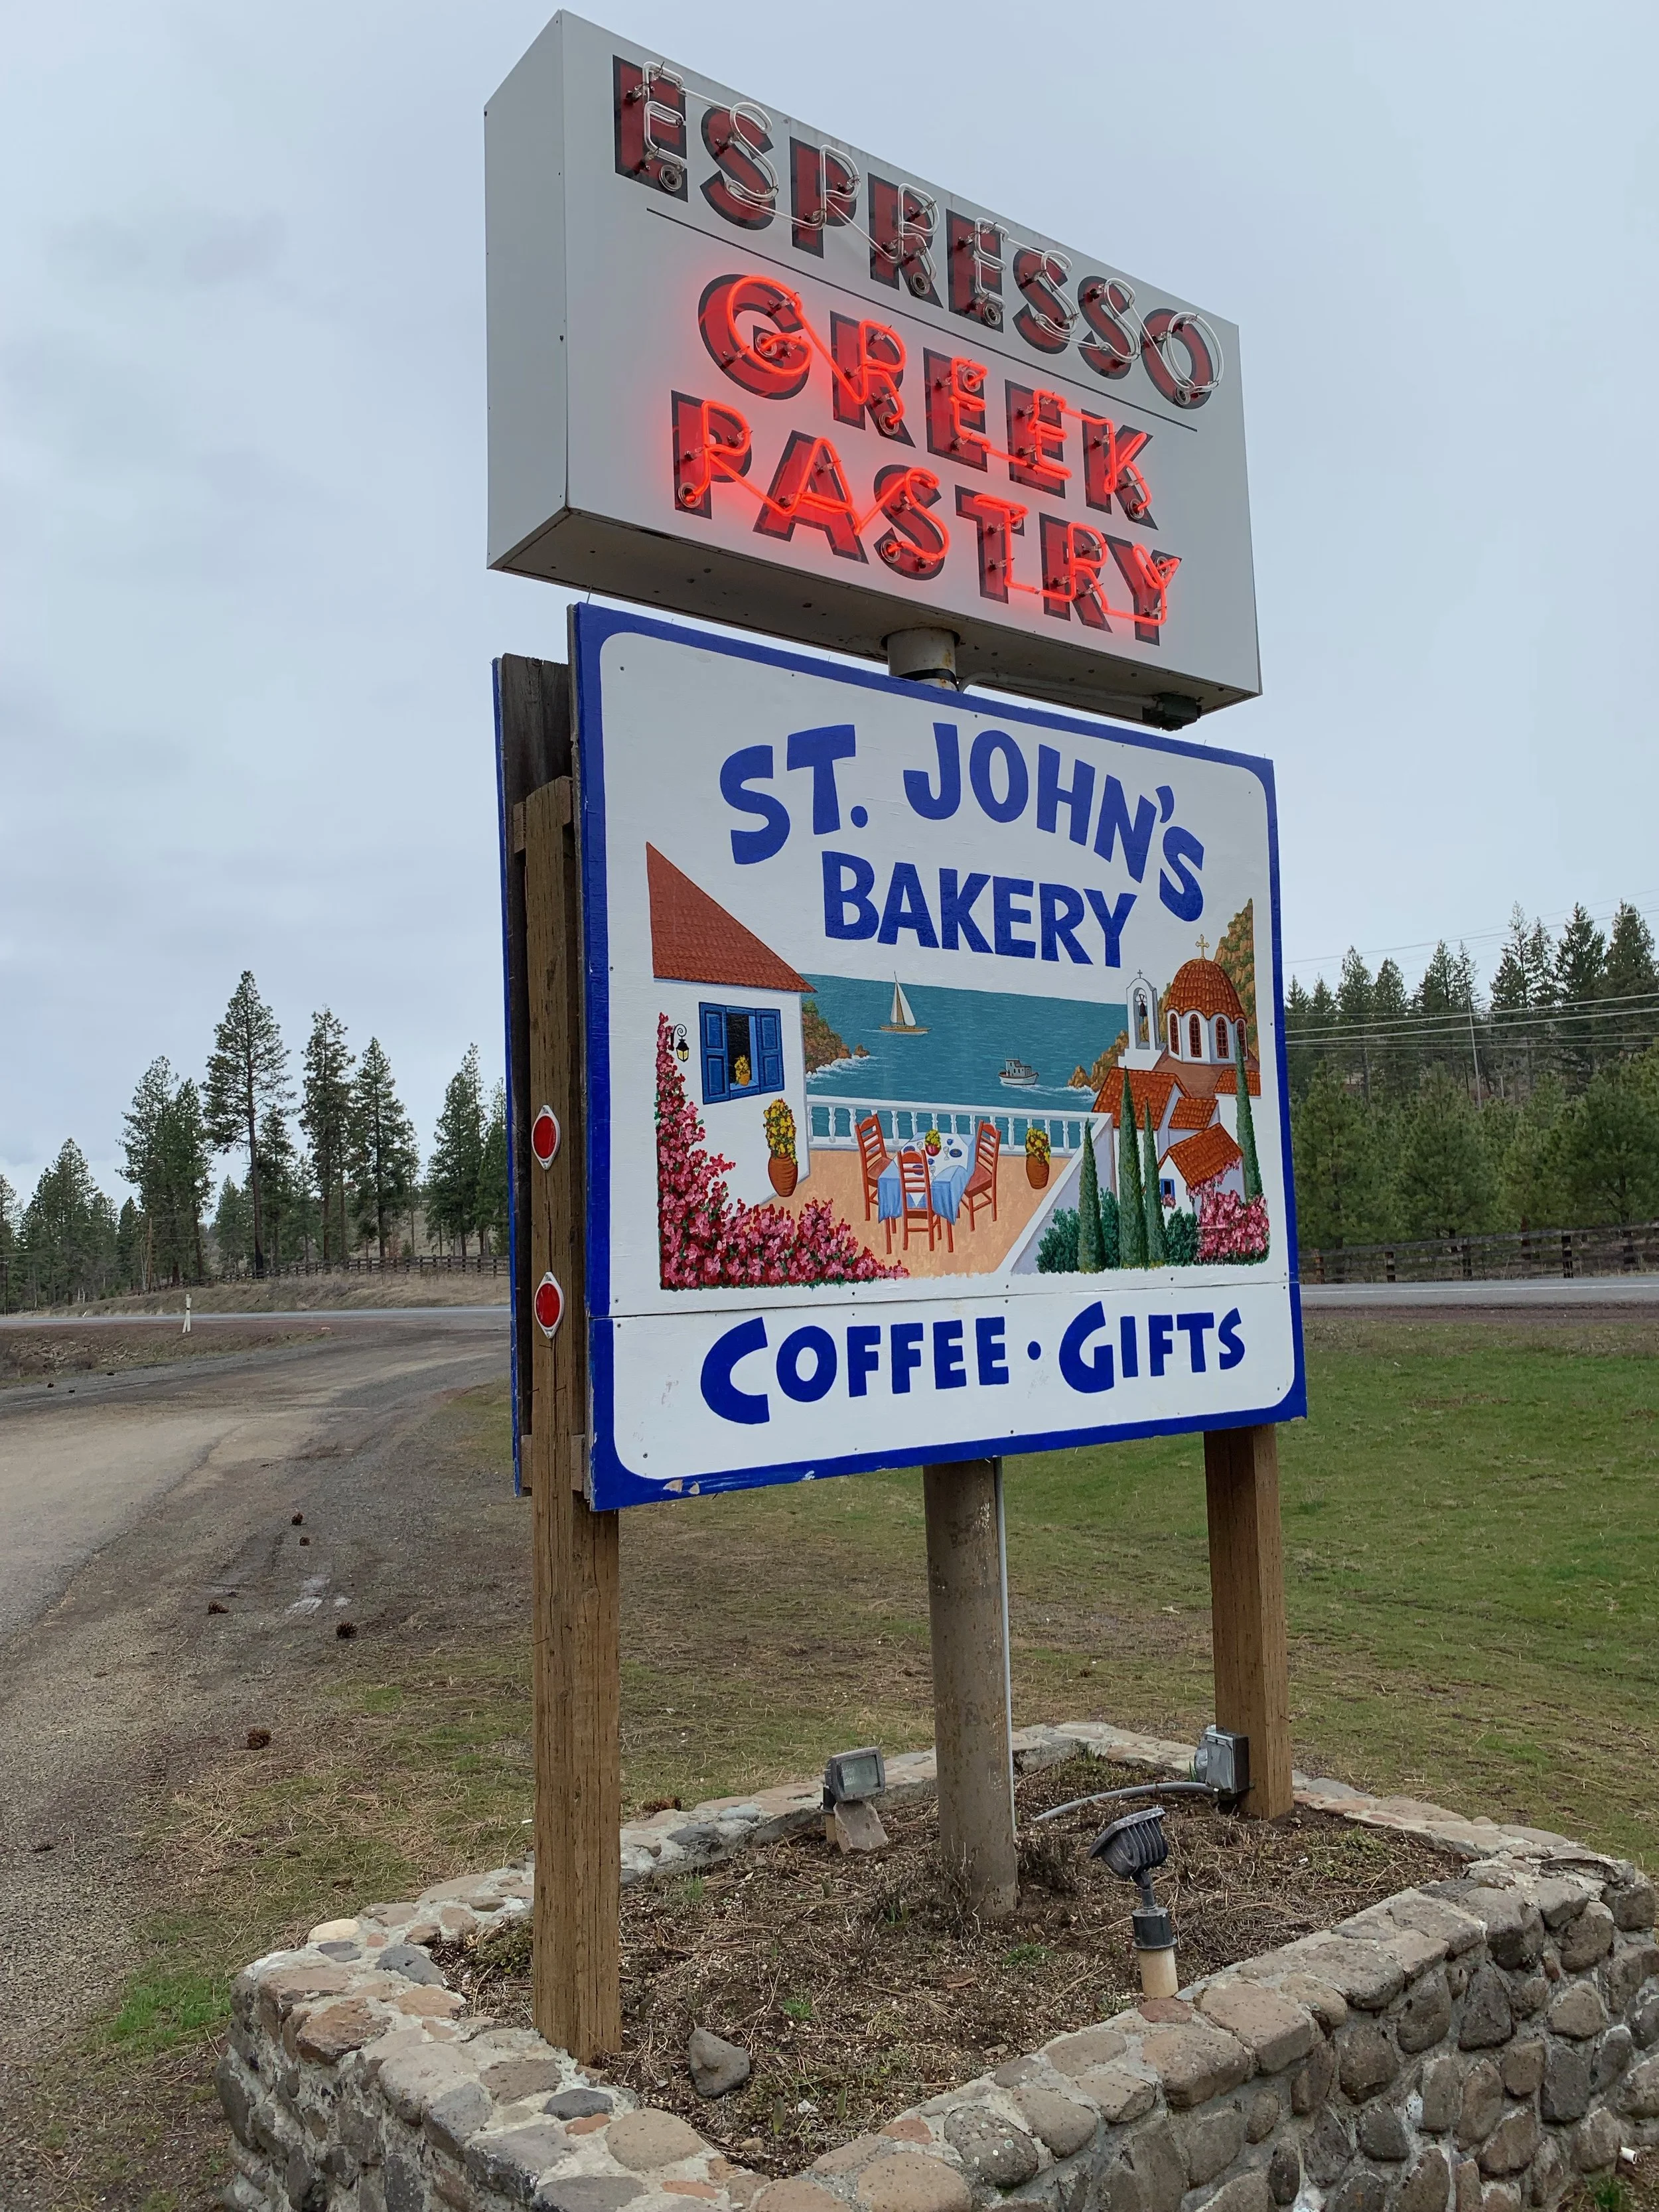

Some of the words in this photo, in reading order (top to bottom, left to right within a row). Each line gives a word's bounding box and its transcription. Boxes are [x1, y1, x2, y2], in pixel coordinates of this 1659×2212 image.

[613, 55, 1223, 409] ESPRESSO
[698, 273, 1158, 530] GREEK
[671, 390, 1181, 646] PASTRY
[720, 725, 868, 864] ST.
[903, 723, 1204, 921] JOHN'S
[822, 851, 1137, 968] BAKERY
[701, 1317, 1009, 1424] COFFEE
[1059, 1301, 1245, 1393] GIFTS
